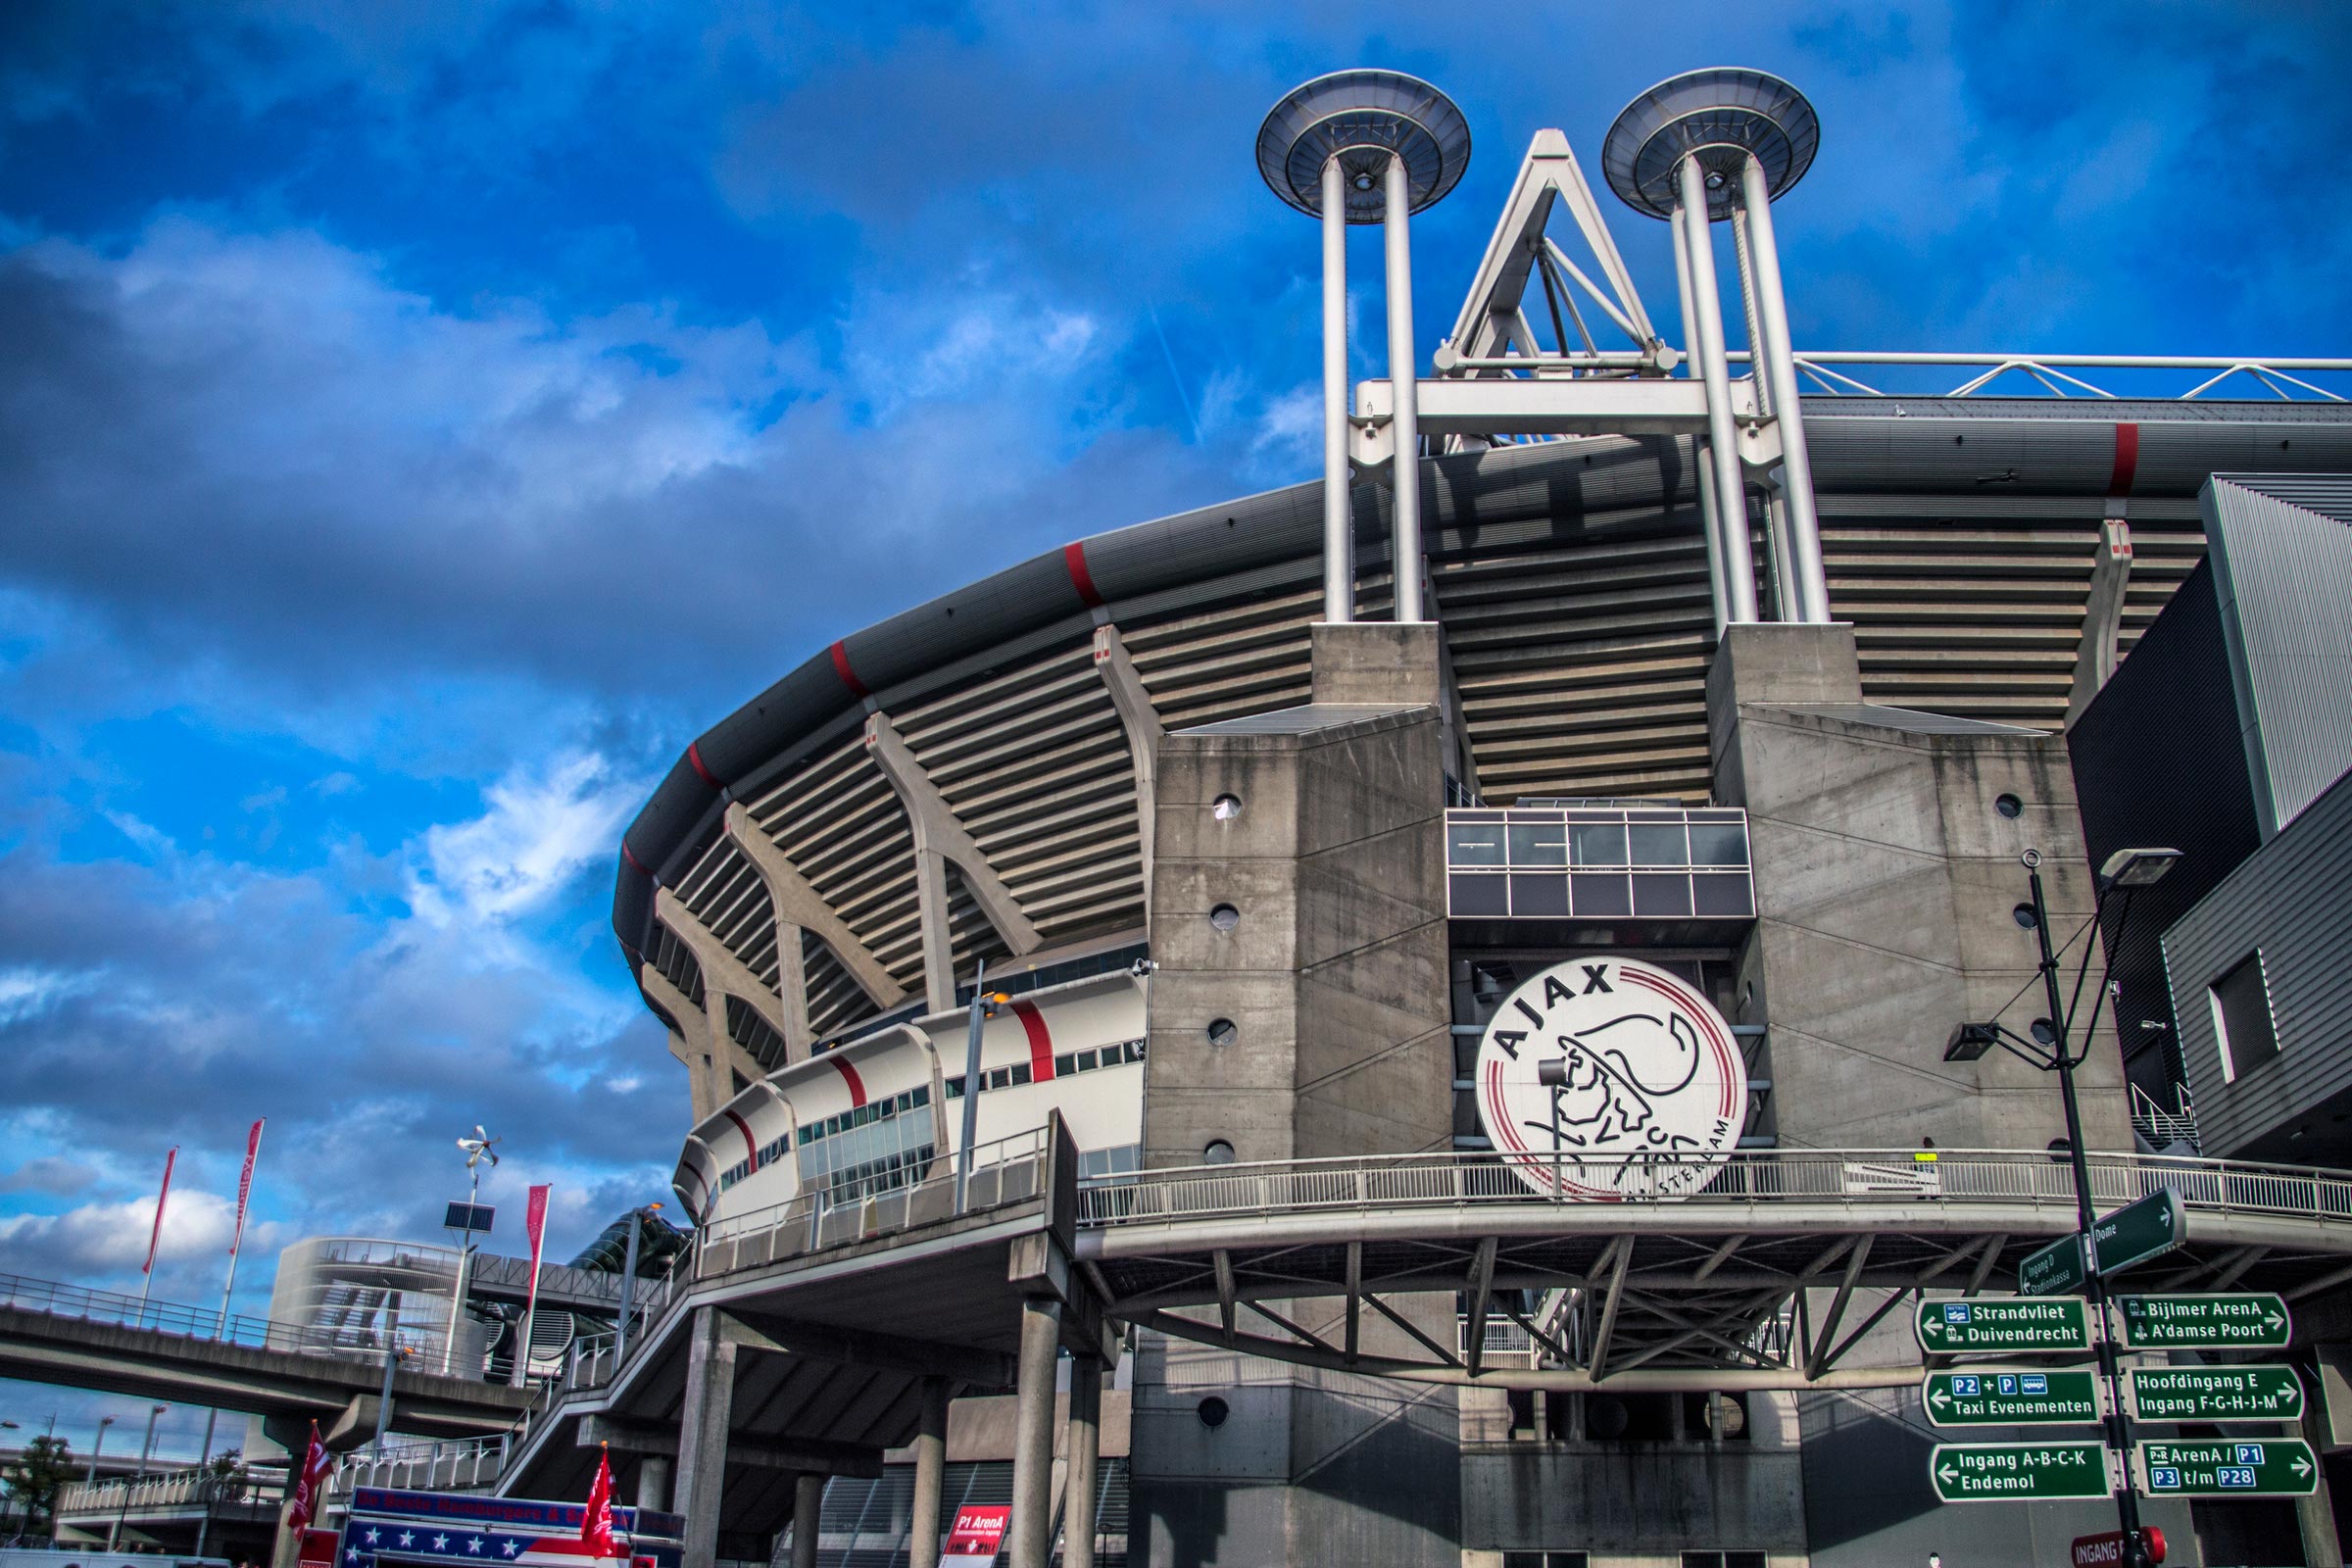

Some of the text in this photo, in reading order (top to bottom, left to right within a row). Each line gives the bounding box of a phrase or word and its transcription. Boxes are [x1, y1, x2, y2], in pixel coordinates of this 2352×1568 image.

[1493, 963, 1614, 1061] AJAX
[2095, 1223, 2117, 1243] Dome
[2028, 1258, 2048, 1278] Ingang
[2031, 1269, 2071, 1297] Stadionkassa
[1974, 1305, 2065, 1320] Strandvliet
[2148, 1301, 2262, 1319] Bijlmer ArenA
[1968, 1327, 2079, 1342] Duivendrecht
[2152, 1323, 2265, 1338] A'damse Poort
[2136, 1373, 2258, 1392] Hoofdingang E
[1953, 1399, 2092, 1415] Taxi Evenementen
[2140, 1395, 2278, 1414] Ingang F-G-H-J-M
[1959, 1450, 2086, 1470] Ingang A-B-C-K
[2171, 1447, 2223, 1463] ArenA
[1961, 1474, 2035, 1491] Endemol
[2184, 1470, 2214, 1485] t/m
[2221, 1470, 2252, 1484] P28
[957, 1515, 1004, 1529] P1 ArenA
[2076, 1541, 2117, 1564] INGANG
